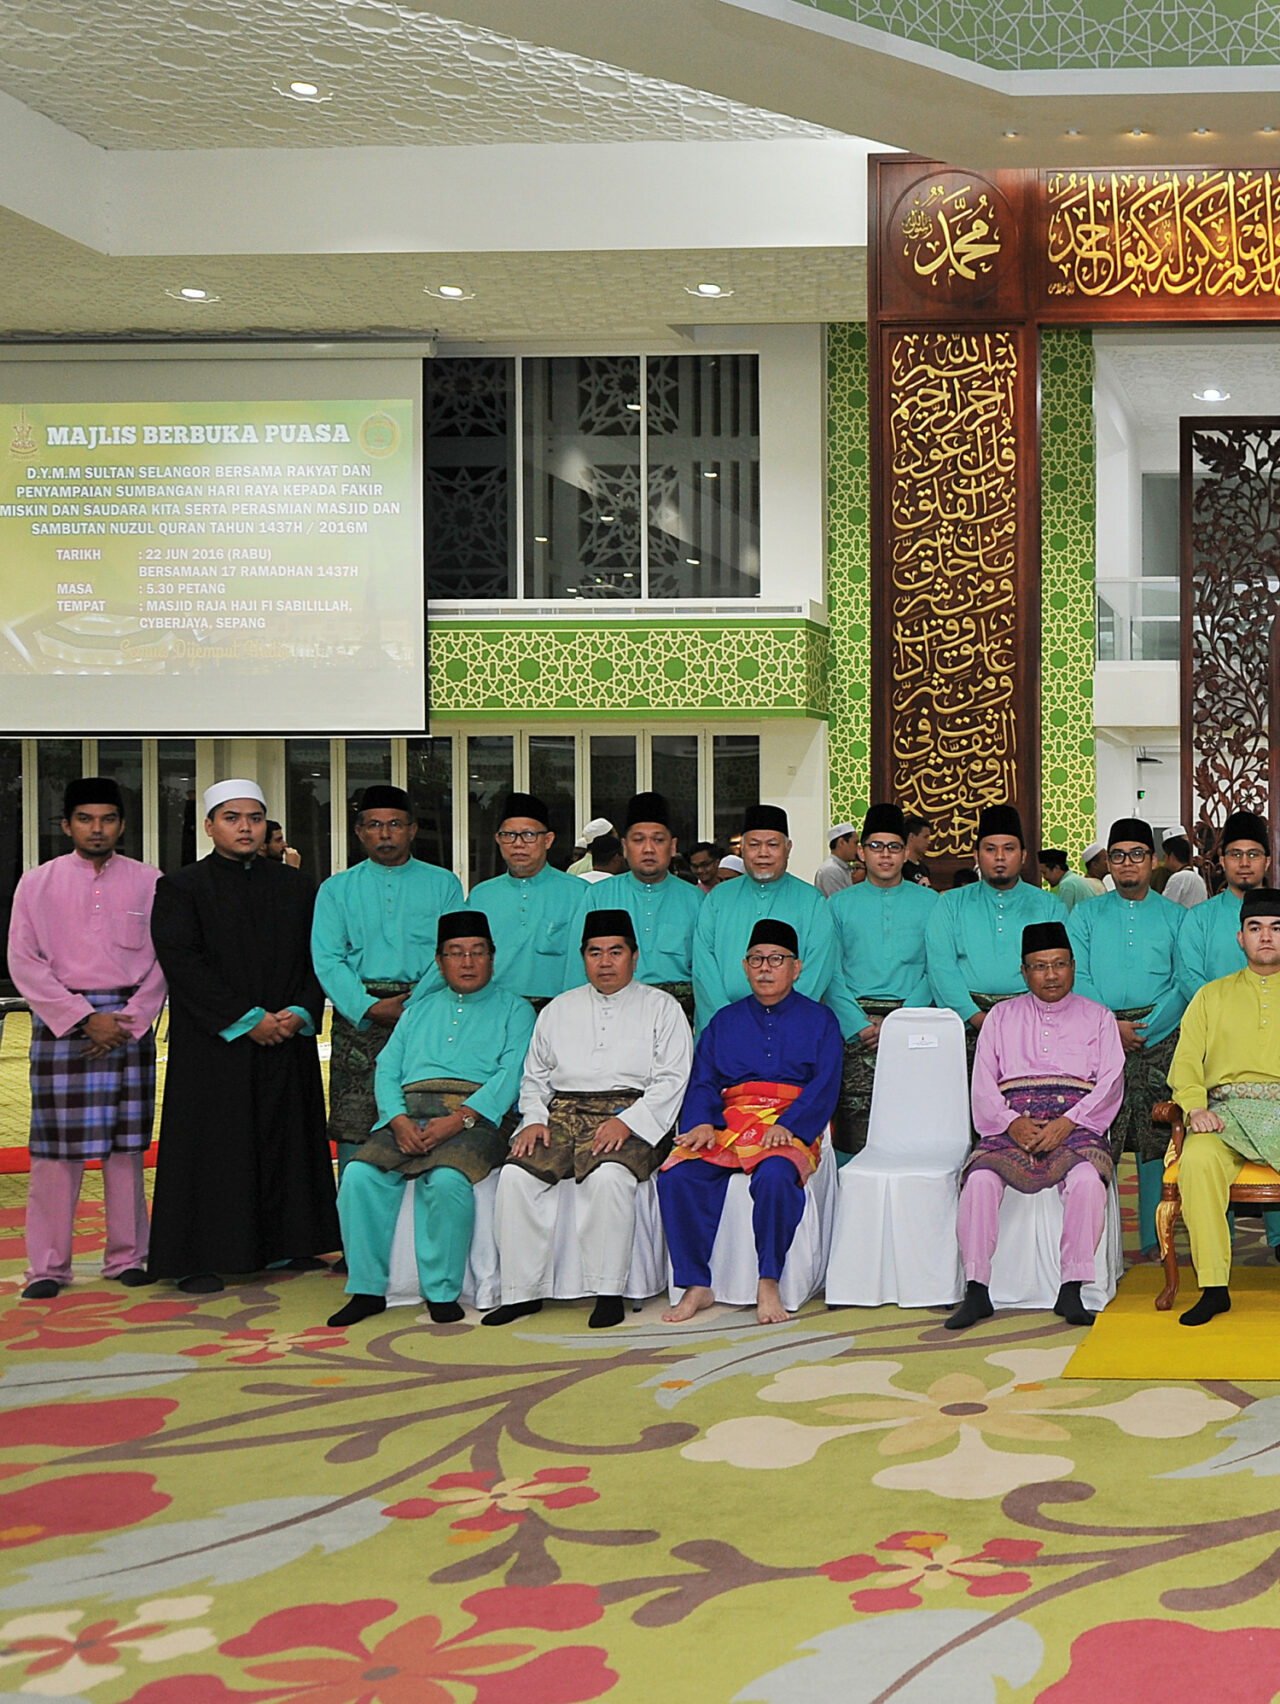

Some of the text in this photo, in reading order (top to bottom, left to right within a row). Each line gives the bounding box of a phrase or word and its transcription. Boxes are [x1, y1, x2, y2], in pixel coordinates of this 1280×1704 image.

[47, 423, 351, 449] MAJLIS BERBUKA PUASA
[27, 464, 371, 479] D.Y.M.M SULTAN SELANGOR BERSAMA RAKYAT DAN
[16, 484, 383, 498] PENYAMPAIAN SUMBANGAN HARI RAYA KEPADA FAKIR
[0, 502, 400, 517] MISKIN DAN SAUDARA KITA SERTA PERASMIAN MASJID DAN
[31, 523, 106, 535] SAMBUTAN
[110, 522, 155, 534] NUZUL
[158, 522, 205, 535] QURAN
[210, 522, 255, 533] TAHUN
[259, 522, 303, 533] 1437H
[319, 521, 368, 533] 2016M
[56, 549, 101, 560] TARIKH
[146, 549, 162, 560] 22
[165, 549, 188, 560] JUN
[192, 549, 224, 560] 2016
[228, 548, 271, 561] (RABU)
[139, 566, 359, 577] BERSAMAAN 17 RAMADHAN 1437H
[57, 584, 93, 594] MASA
[147, 583, 174, 594] 5.30
[178, 583, 226, 594] PETANG
[57, 601, 106, 612] TEMPAT
[147, 600, 192, 611] MASJID
[197, 600, 227, 611] RAJA
[231, 600, 257, 611] HAJI
[261, 600, 273, 611] FI
[216, 618, 266, 628] SEPANG
